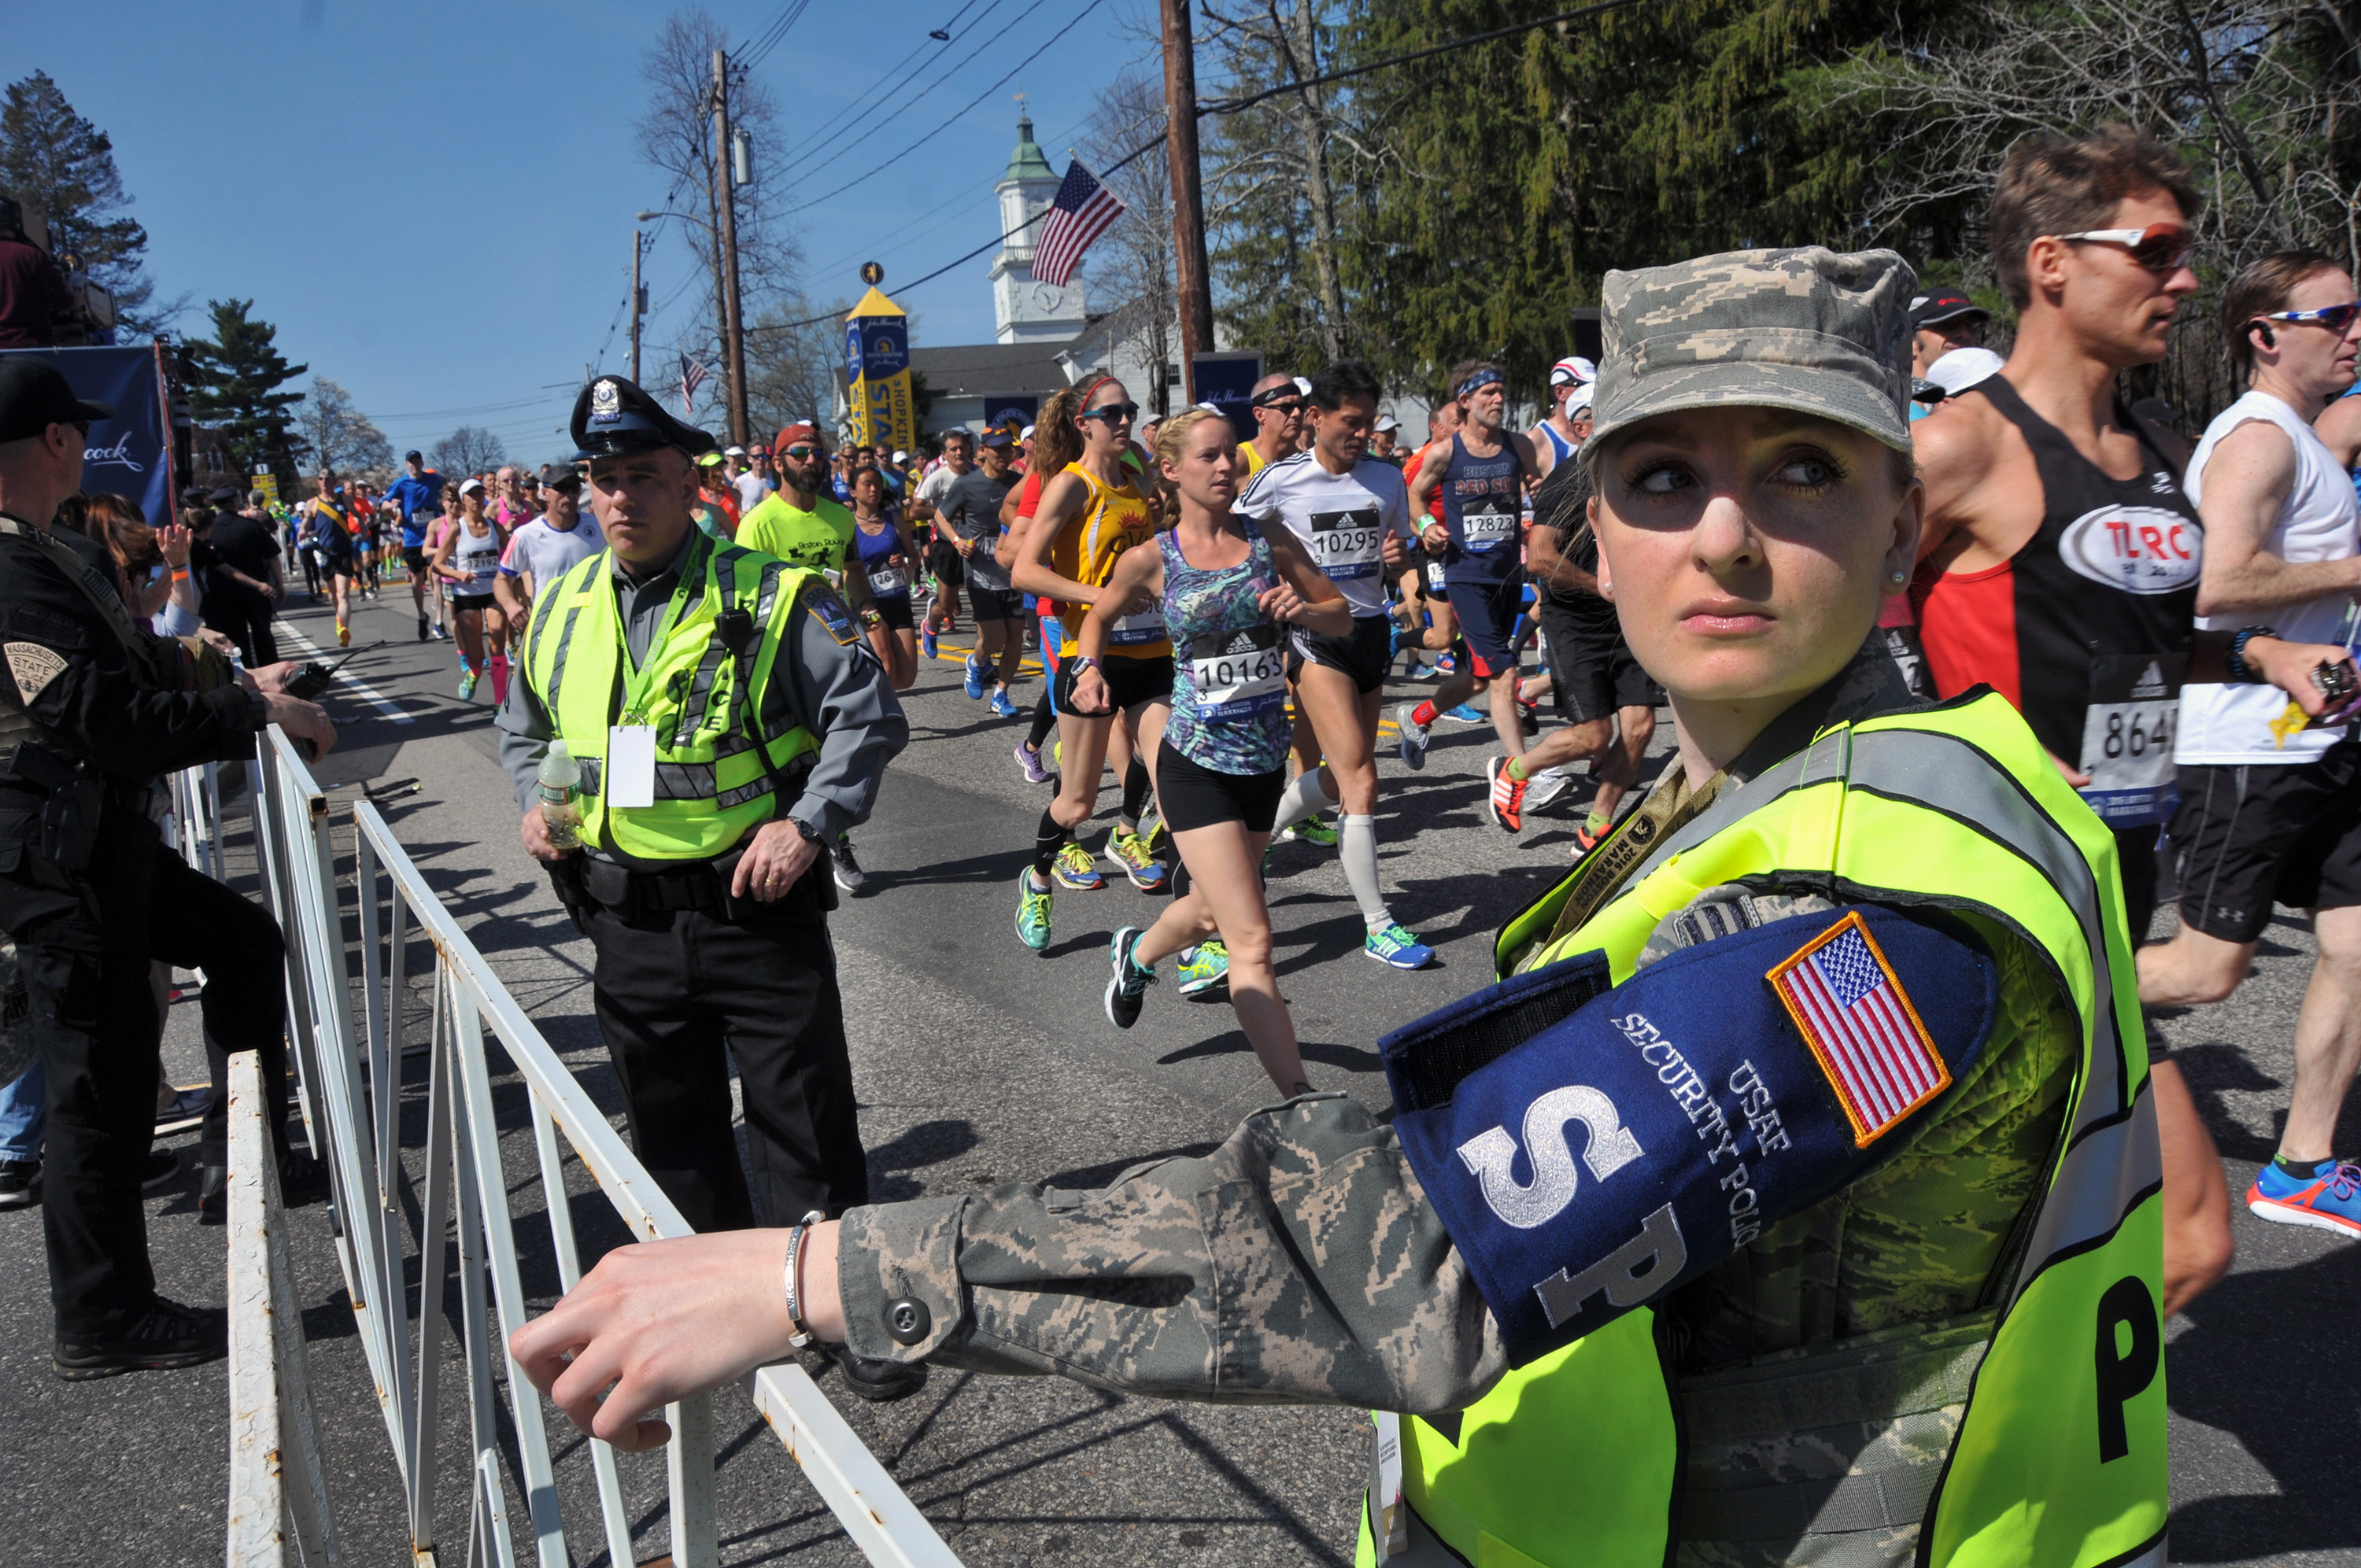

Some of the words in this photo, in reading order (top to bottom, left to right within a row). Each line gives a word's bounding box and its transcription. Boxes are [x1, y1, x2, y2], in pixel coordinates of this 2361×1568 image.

[1464, 463, 1511, 478] BOSTON
[1454, 478, 1489, 496] RED
[1466, 517, 1513, 533] 12823
[797, 541, 823, 550] Baton
[1316, 529, 1378, 554] 10295
[2104, 522, 2193, 561] TLRC
[468, 557, 498, 568] 12192
[1315, 555, 1323, 566] 3
[6, 644, 65, 670] MASSACHUSETTS
[1226, 644, 1258, 655] adidas
[13, 657, 52, 677] STATE
[16, 668, 45, 684] POLICE
[1199, 651, 1283, 687] 10163
[1199, 688, 1208, 702] 3
[2104, 710, 2177, 759] 864
[1575, 839, 1630, 906] MARATHON
[1616, 846, 1639, 873] 2016
[1580, 870, 1616, 910] BOSTON
[1609, 1013, 1740, 1165] SECURITY
[1729, 1058, 1793, 1157] USAF
[1456, 1084, 1646, 1229] S
[1532, 1201, 1687, 1330] P
[2094, 1275, 2160, 1465] P
